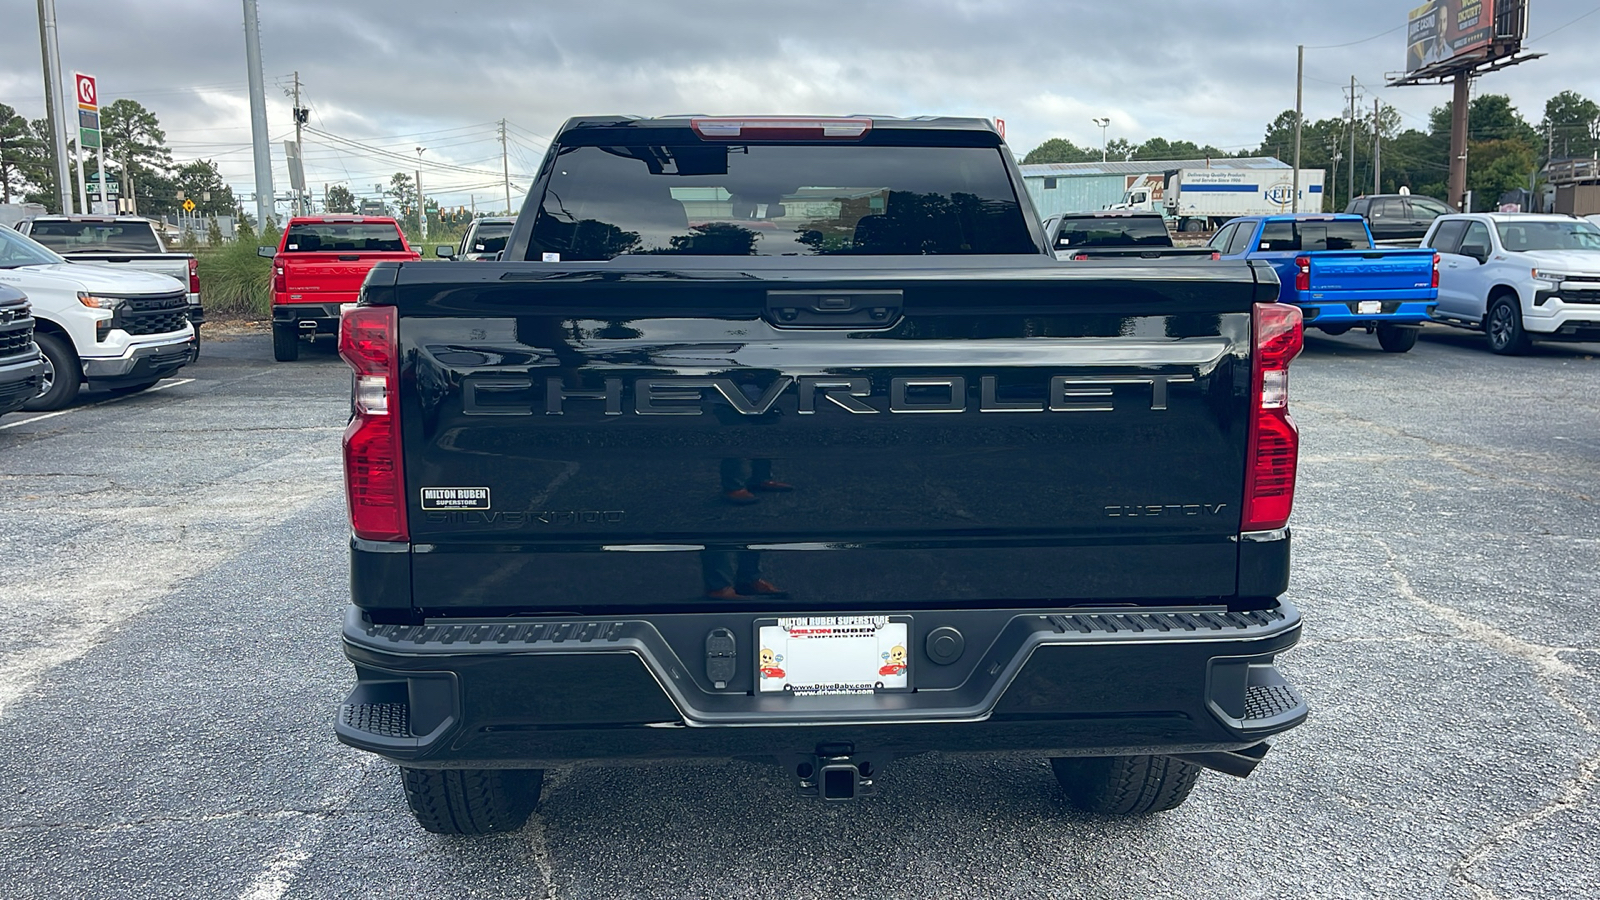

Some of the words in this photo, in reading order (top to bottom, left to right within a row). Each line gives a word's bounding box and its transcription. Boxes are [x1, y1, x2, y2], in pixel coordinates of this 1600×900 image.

[293, 267, 369, 275] CHEVRO
[463, 374, 1195, 416] CHEVROLET
[425, 489, 456, 500] MILTON
[457, 489, 486, 499] RUBEN
[1103, 504, 1227, 516] CUSTOM
[425, 510, 626, 524] SILVERADO
[777, 617, 808, 627] MILTON
[809, 616, 837, 626] RUBEN
[838, 615, 890, 626] SUPERSTORE
[792, 683, 872, 691] www.DriveBaby.com
[793, 689, 874, 697] www.drivebaby.com
